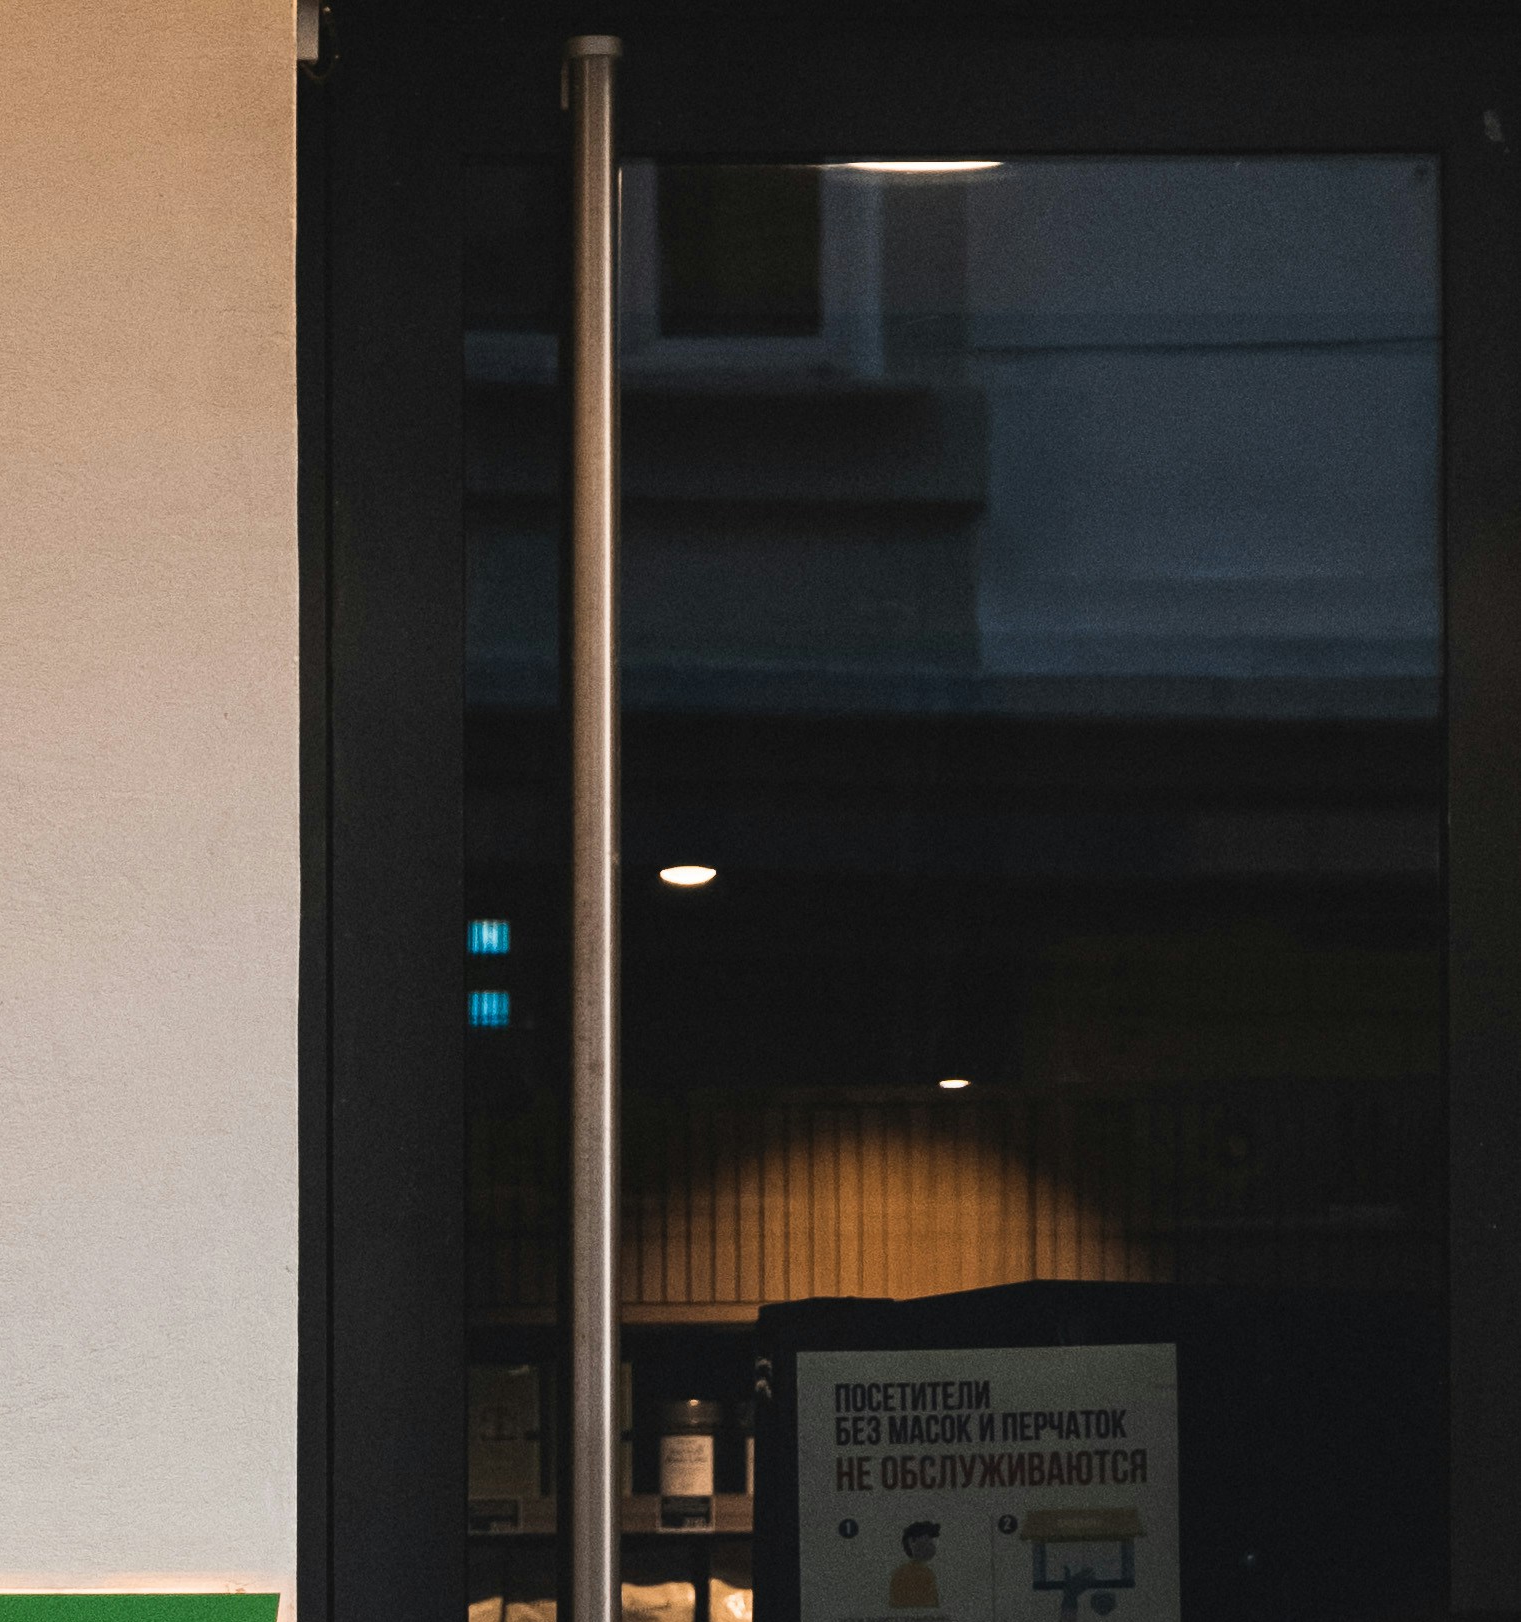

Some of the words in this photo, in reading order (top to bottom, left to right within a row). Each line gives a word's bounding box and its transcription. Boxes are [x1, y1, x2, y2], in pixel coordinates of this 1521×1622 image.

[835, 1380, 991, 1412] ПОСЕТИТЕЛИ
[835, 1416, 881, 1446] БЕЗ
[888, 1413, 971, 1445] МАСОК
[978, 1412, 995, 1442] И
[1001, 1409, 1128, 1441] ПЕРЧАТОК
[835, 1456, 873, 1492] НЕ
[881, 1449, 1148, 1490] ОБСЛУЖИВАЮТСЯ
